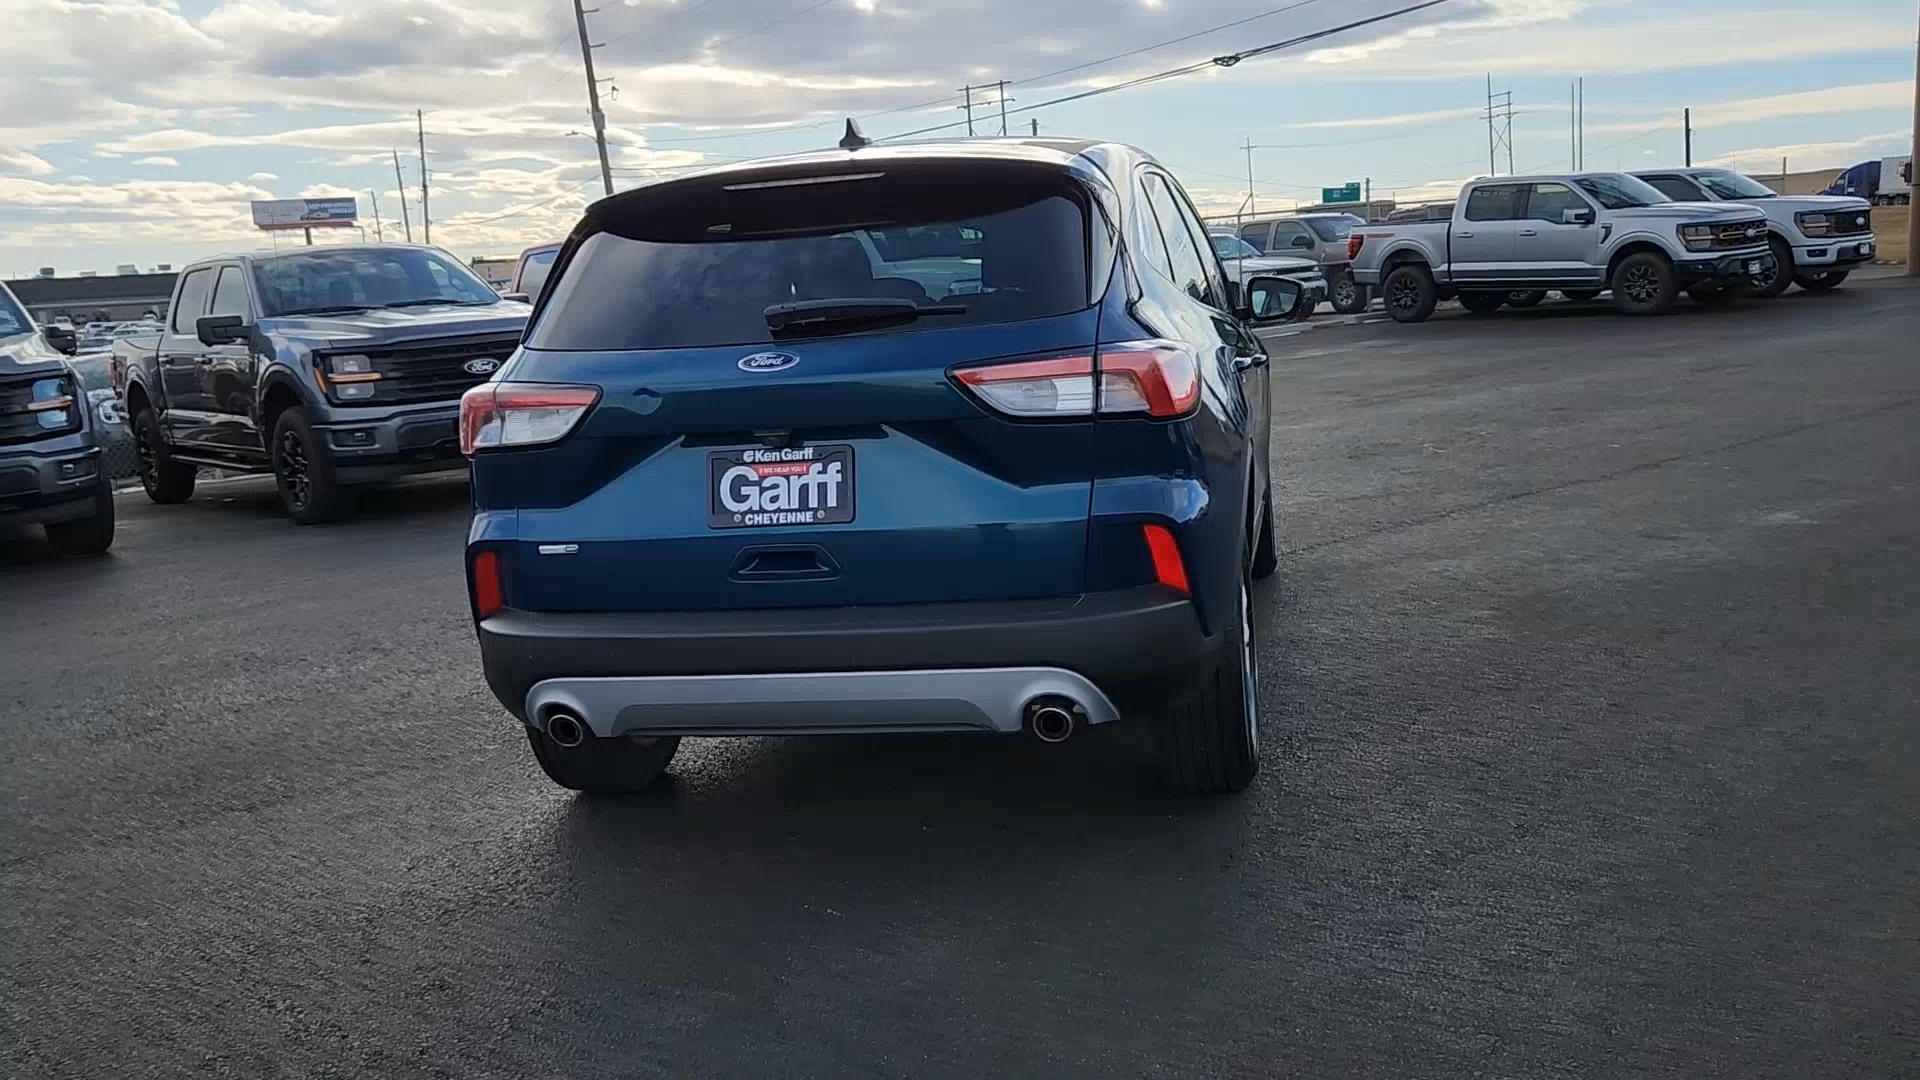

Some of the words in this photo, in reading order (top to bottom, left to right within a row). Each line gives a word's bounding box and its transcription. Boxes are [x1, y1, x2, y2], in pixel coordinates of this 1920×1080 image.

[751, 354, 785, 367] Ford
[755, 450, 780, 462] Ken
[781, 447, 814, 460] Garff
[720, 461, 842, 513] Garff
[745, 511, 814, 525] CHEYENNE
